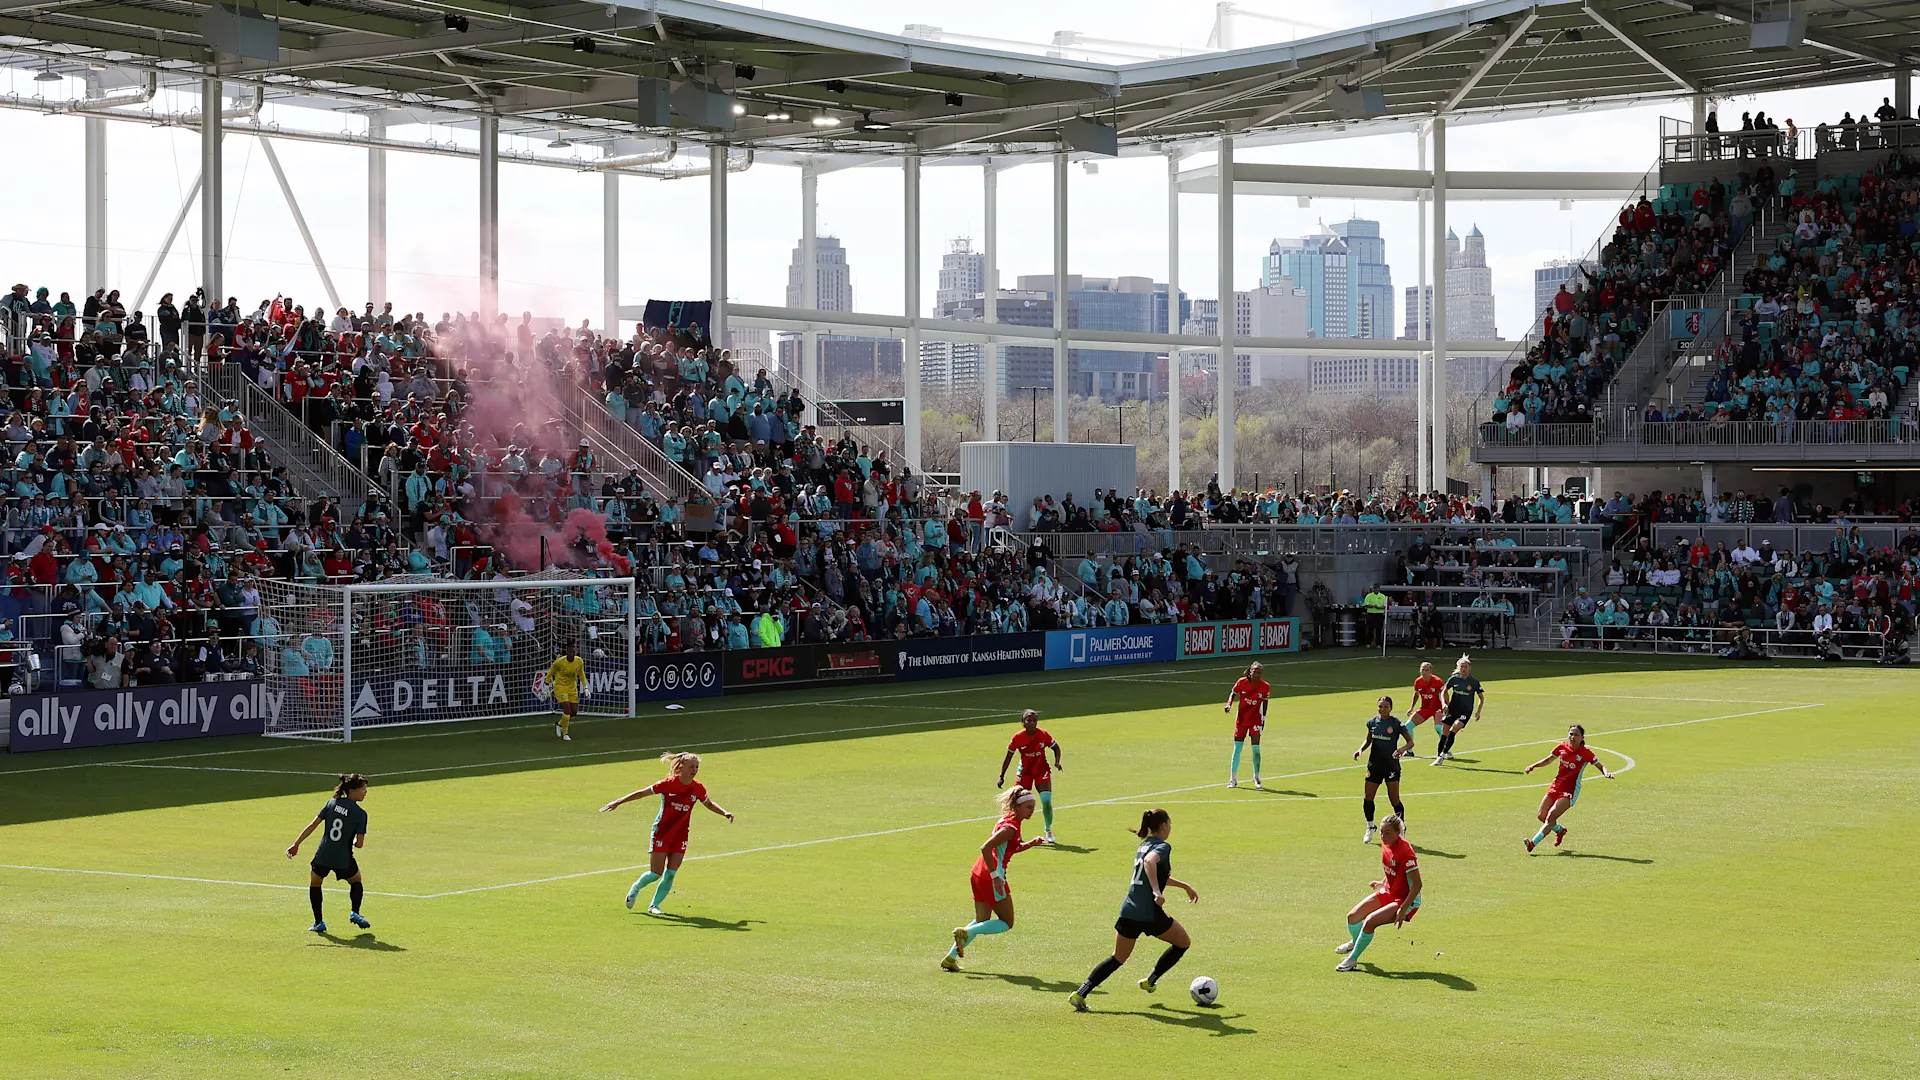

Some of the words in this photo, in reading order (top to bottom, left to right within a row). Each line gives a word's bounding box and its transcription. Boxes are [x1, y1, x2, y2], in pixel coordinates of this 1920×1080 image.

[1090, 637, 1123, 652] PALMER
[1122, 634, 1153, 650] SQUARE
[1192, 629, 1214, 652] BABY
[1229, 627, 1251, 649] BABY
[1267, 624, 1289, 647] BABY
[742, 656, 794, 679] CPKC
[908, 656, 922, 667] THE
[922, 654, 959, 666] UNIVERSITY
[960, 653, 969, 663] OF
[972, 651, 996, 662] KANSAS
[997, 650, 1020, 660] HEALTH
[1020, 648, 1043, 659] SYSTEM
[1114, 652, 1152, 661] MANAGEMENT
[393, 674, 508, 712] DELTA
[93, 692, 155, 738] ally
[159, 687, 218, 732] ally
[229, 683, 286, 727] ally
[18, 696, 82, 744] ally
[330, 818, 343, 841] 8
